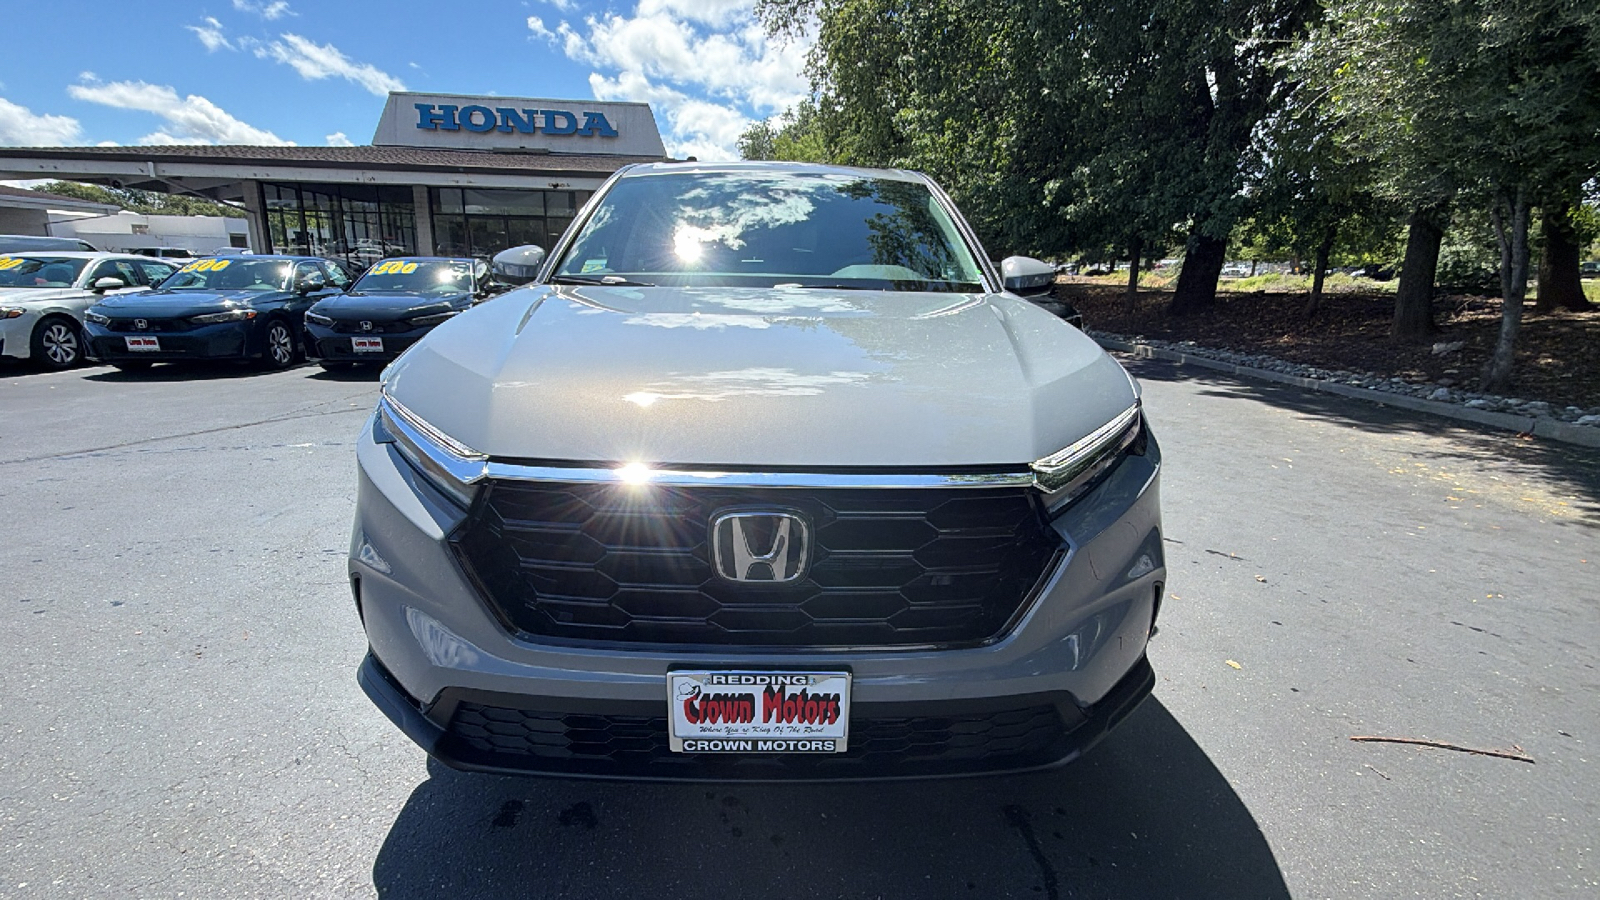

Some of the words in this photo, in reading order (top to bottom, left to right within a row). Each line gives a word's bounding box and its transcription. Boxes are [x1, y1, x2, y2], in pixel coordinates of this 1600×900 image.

[415, 103, 618, 137] HONDA
[712, 675, 807, 685] REDDING
[683, 687, 755, 725] Crown
[762, 685, 841, 725] Motors
[751, 726, 771, 734] King
[773, 726, 784, 735] Of
[802, 726, 825, 734] Road
[683, 740, 752, 751] CROWN
[757, 740, 835, 751] MOTORS
